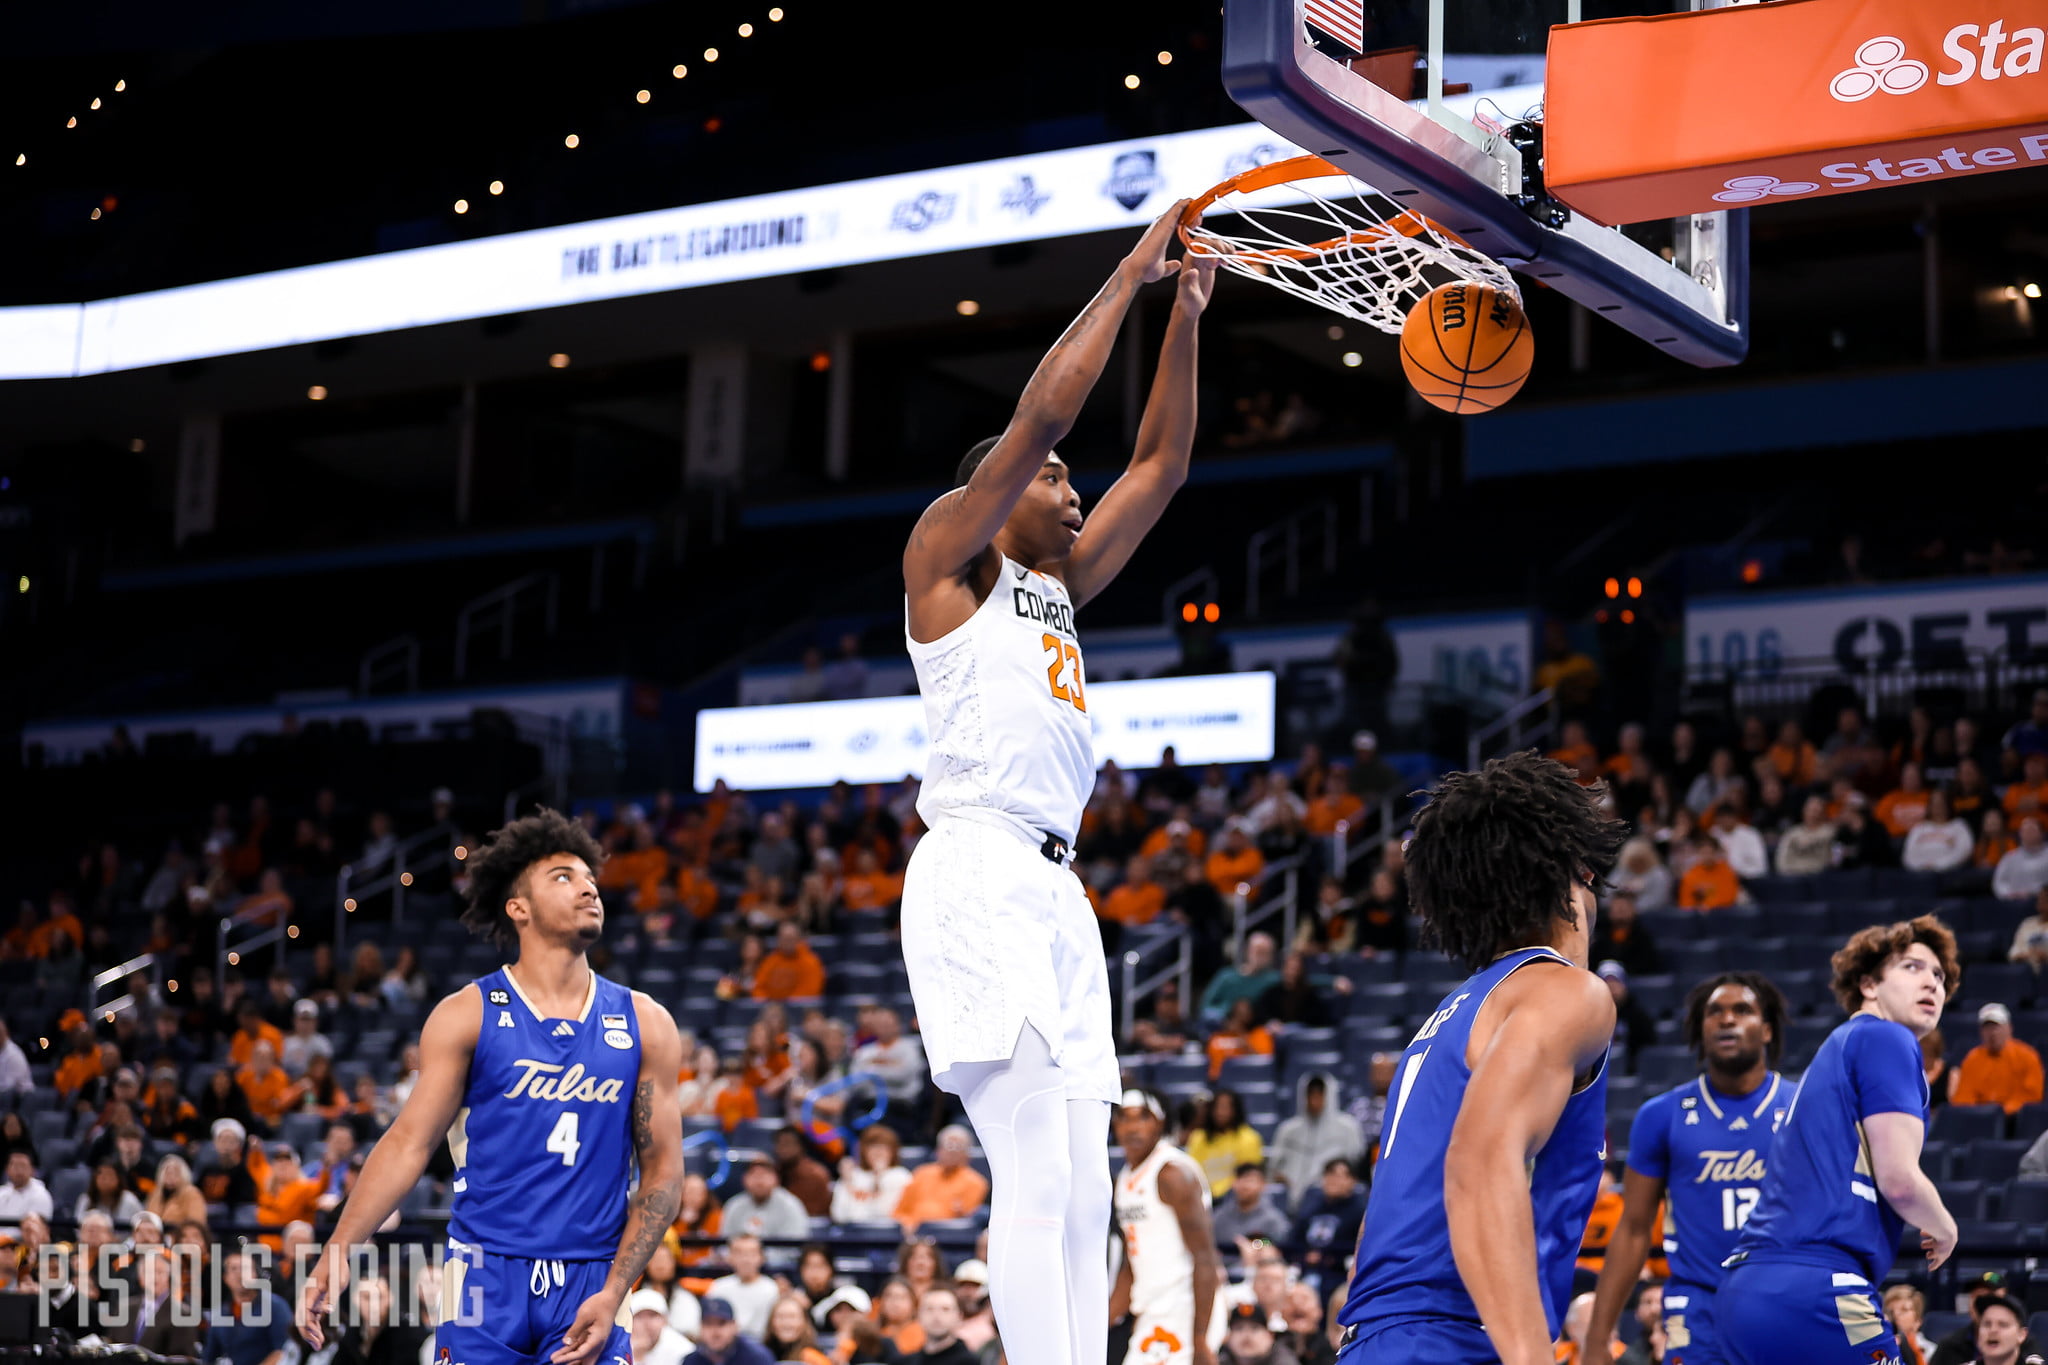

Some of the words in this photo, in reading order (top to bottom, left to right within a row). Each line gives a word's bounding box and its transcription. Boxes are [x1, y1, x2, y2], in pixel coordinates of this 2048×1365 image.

[1936, 19, 2048, 86] Sta
[1820, 146, 2017, 188] State
[1013, 587, 1078, 640] COWBO
[1042, 632, 1086, 713] 23
[503, 1058, 624, 1104] Tulsa
[546, 1111, 581, 1167] 4
[1695, 1149, 1767, 1184] Tuls
[1722, 1187, 1762, 1231] 12
